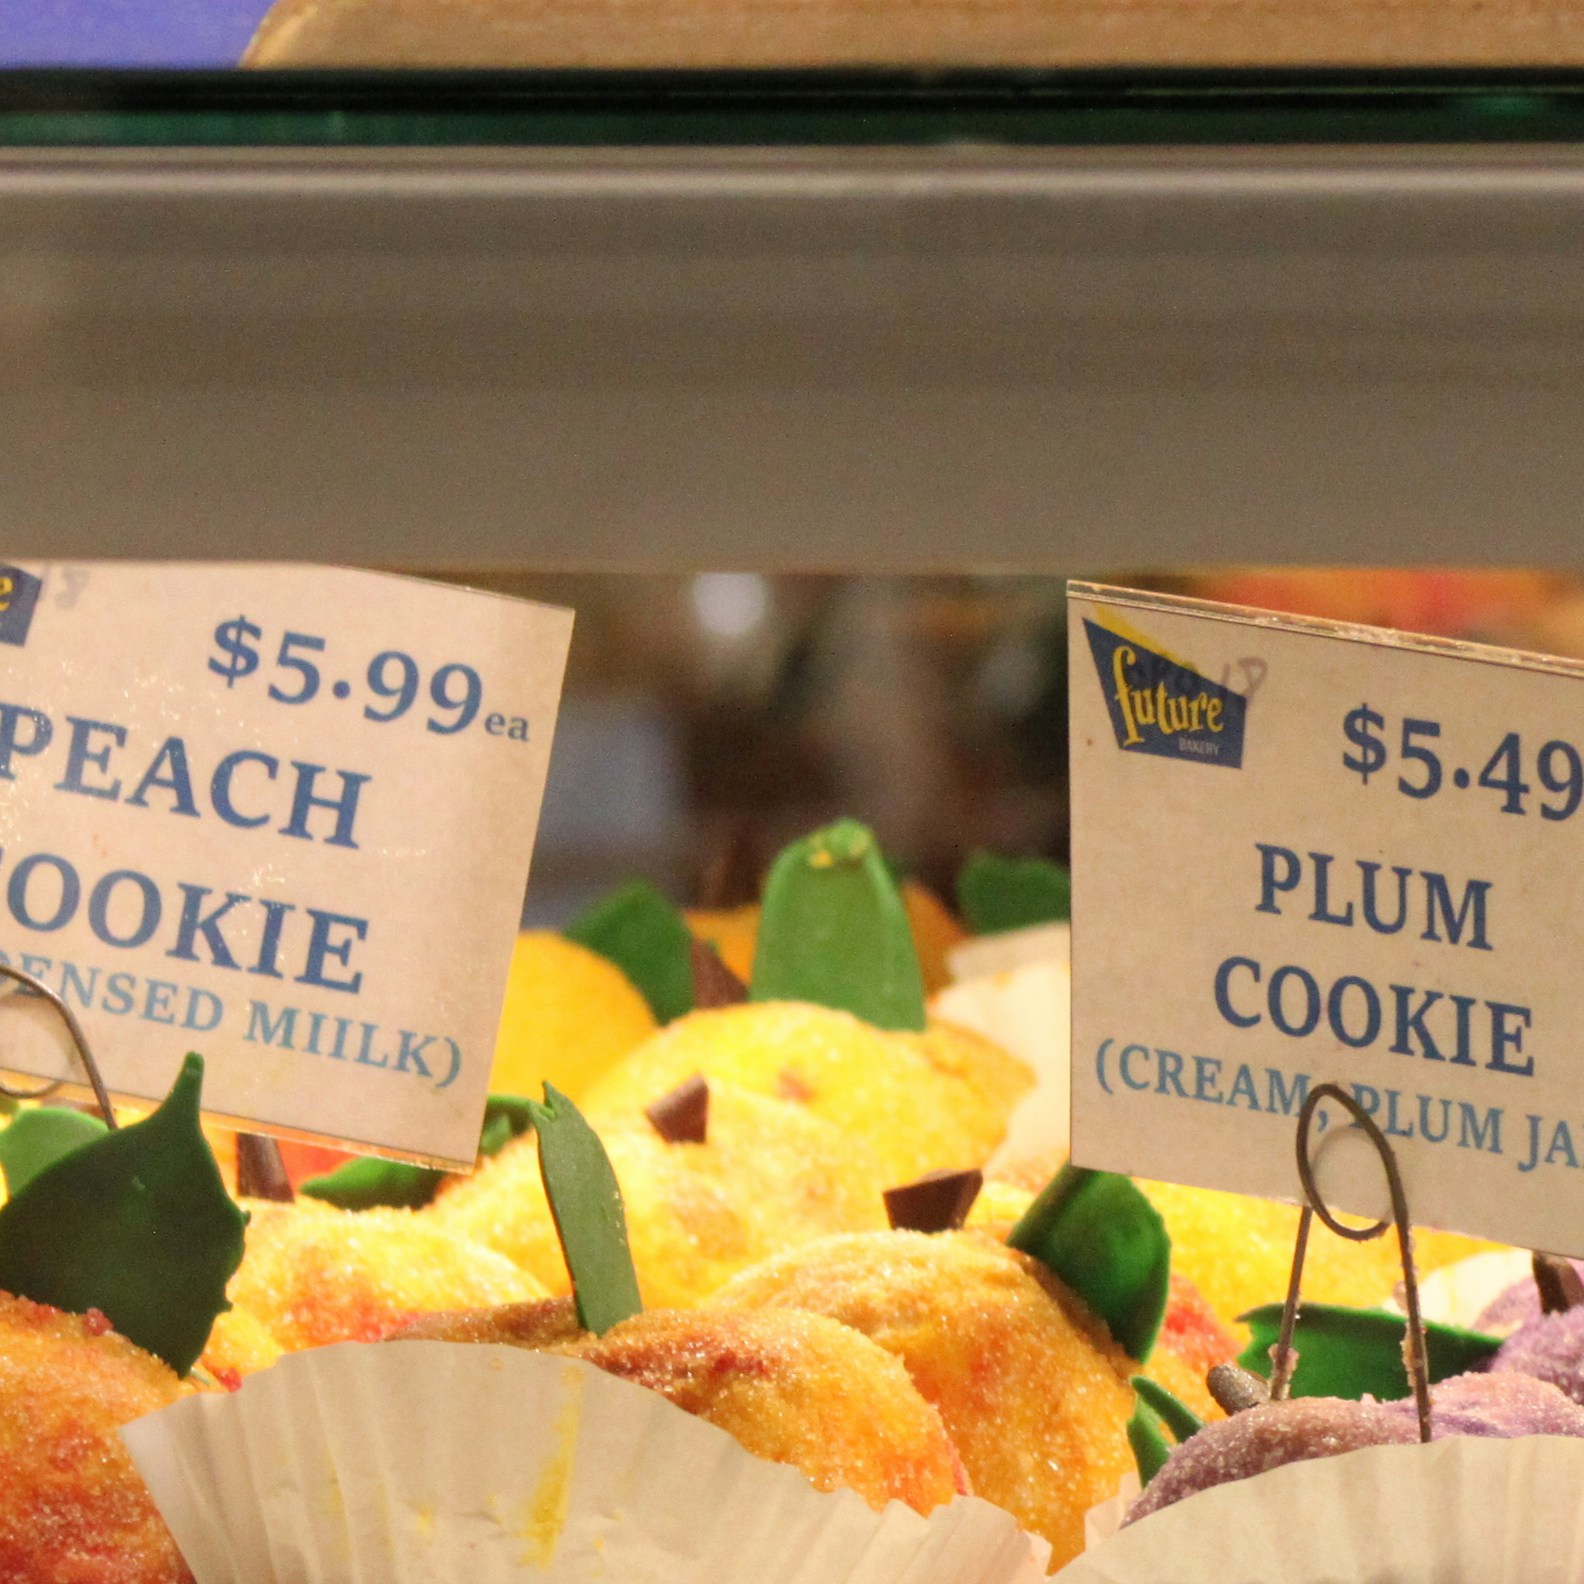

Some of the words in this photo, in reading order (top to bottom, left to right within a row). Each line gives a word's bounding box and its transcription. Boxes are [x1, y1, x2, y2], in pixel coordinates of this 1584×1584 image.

[208, 614, 531, 743] $5.99ea
[1113, 646, 1225, 746] future
[0, 703, 372, 850] PEACH
[0, 847, 370, 996] OOKIE
[1255, 842, 1494, 952] PLUM
[244, 998, 464, 1089] MIILK)
[1213, 955, 1535, 1078] COOKIE
[1094, 1037, 1329, 1133] (CREAM,
[1349, 1082, 1504, 1155] PLUM
